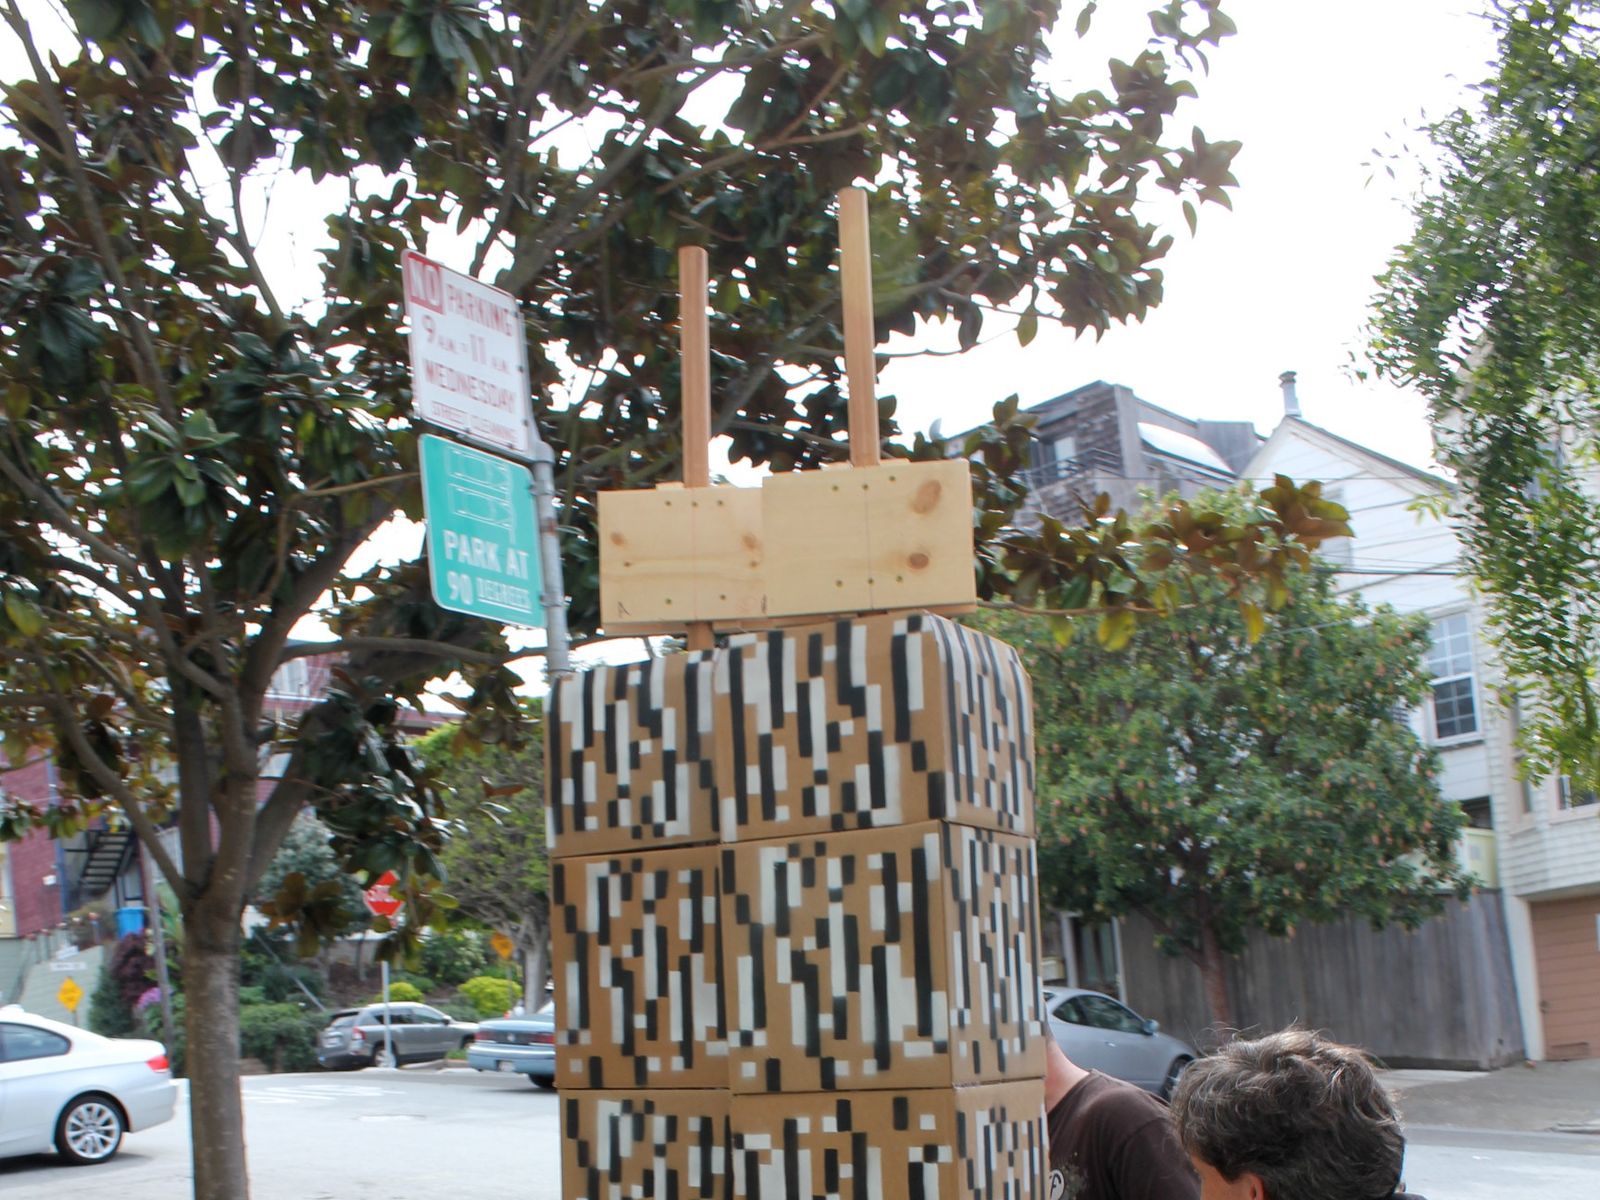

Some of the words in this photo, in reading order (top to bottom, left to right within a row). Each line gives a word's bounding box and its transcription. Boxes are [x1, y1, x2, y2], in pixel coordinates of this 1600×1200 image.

[409, 258, 439, 307] NO
[446, 284, 513, 337] PARKING
[422, 357, 516, 414] WEDNESDAY
[443, 529, 501, 573] PARK
[506, 547, 529, 579] AT
[447, 570, 473, 605] 90
